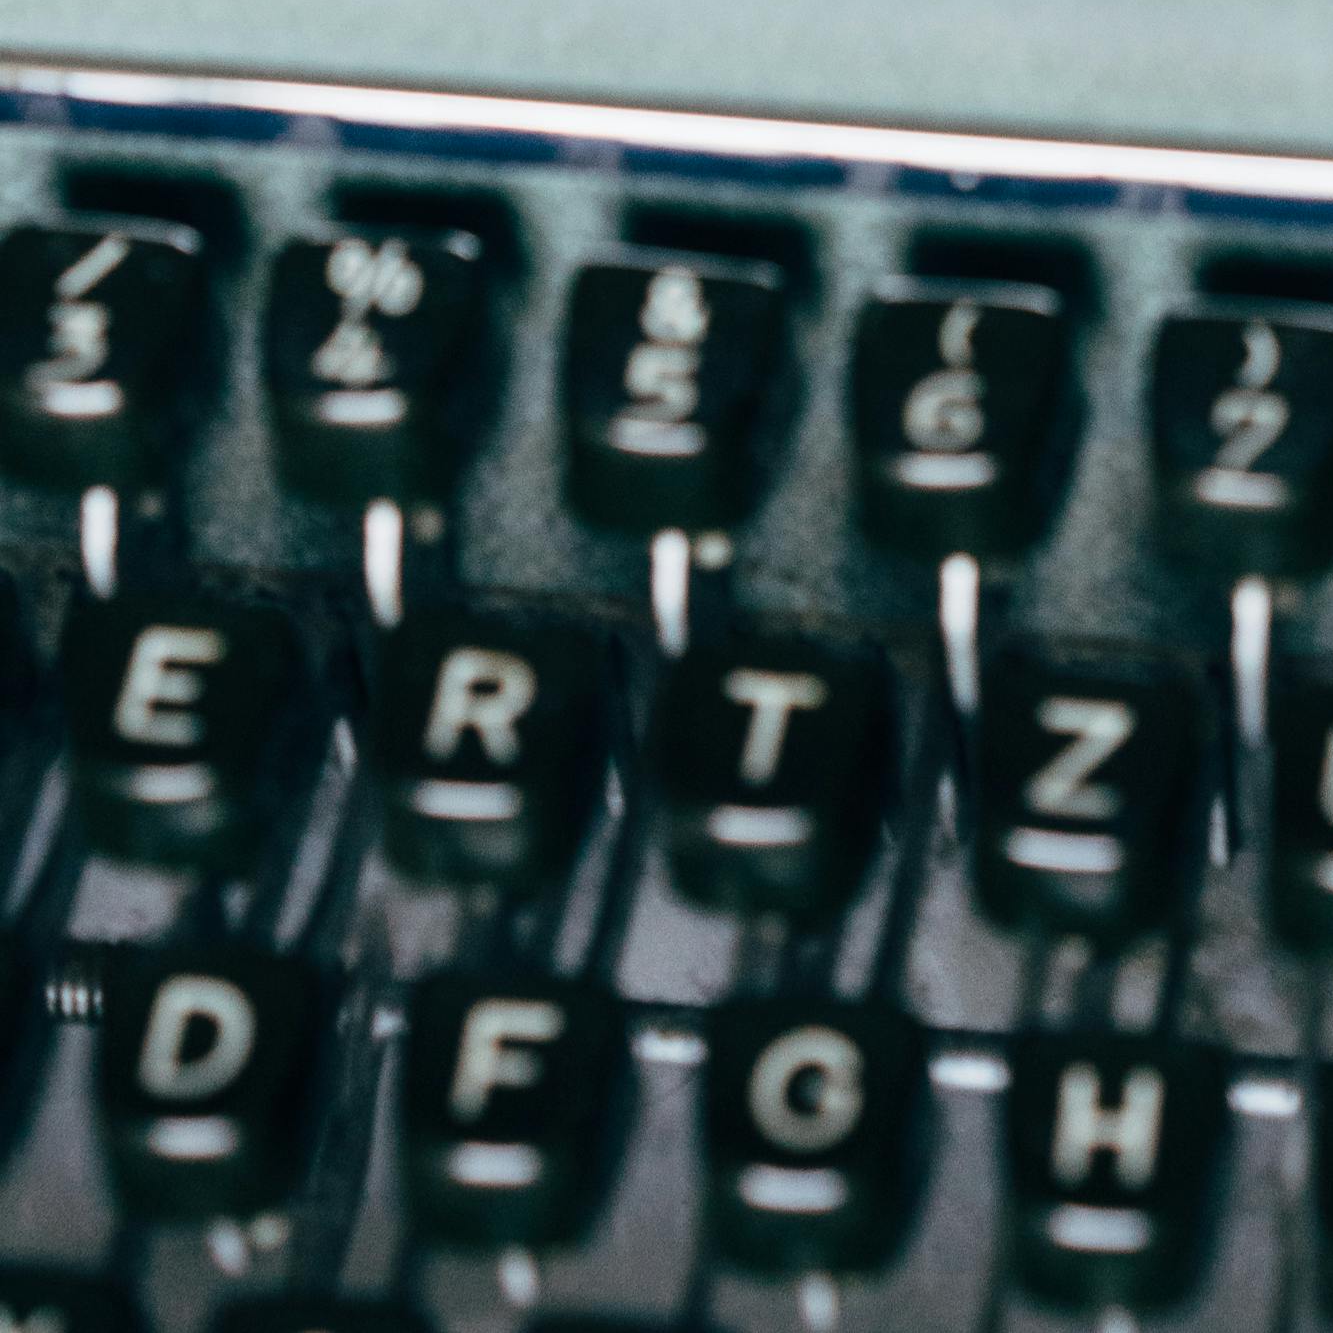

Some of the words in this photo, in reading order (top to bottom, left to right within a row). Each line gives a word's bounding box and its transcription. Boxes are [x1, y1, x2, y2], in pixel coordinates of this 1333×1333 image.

[903, 368, 985, 454] 6
[115, 624, 226, 746] E
[424, 646, 538, 766] R
[725, 668, 828, 784] T
[1025, 696, 1135, 820] Z
[137, 972, 256, 1102] D
[448, 997, 566, 1124] F
[747, 1024, 864, 1152] G
[1050, 1062, 1166, 1188] H
